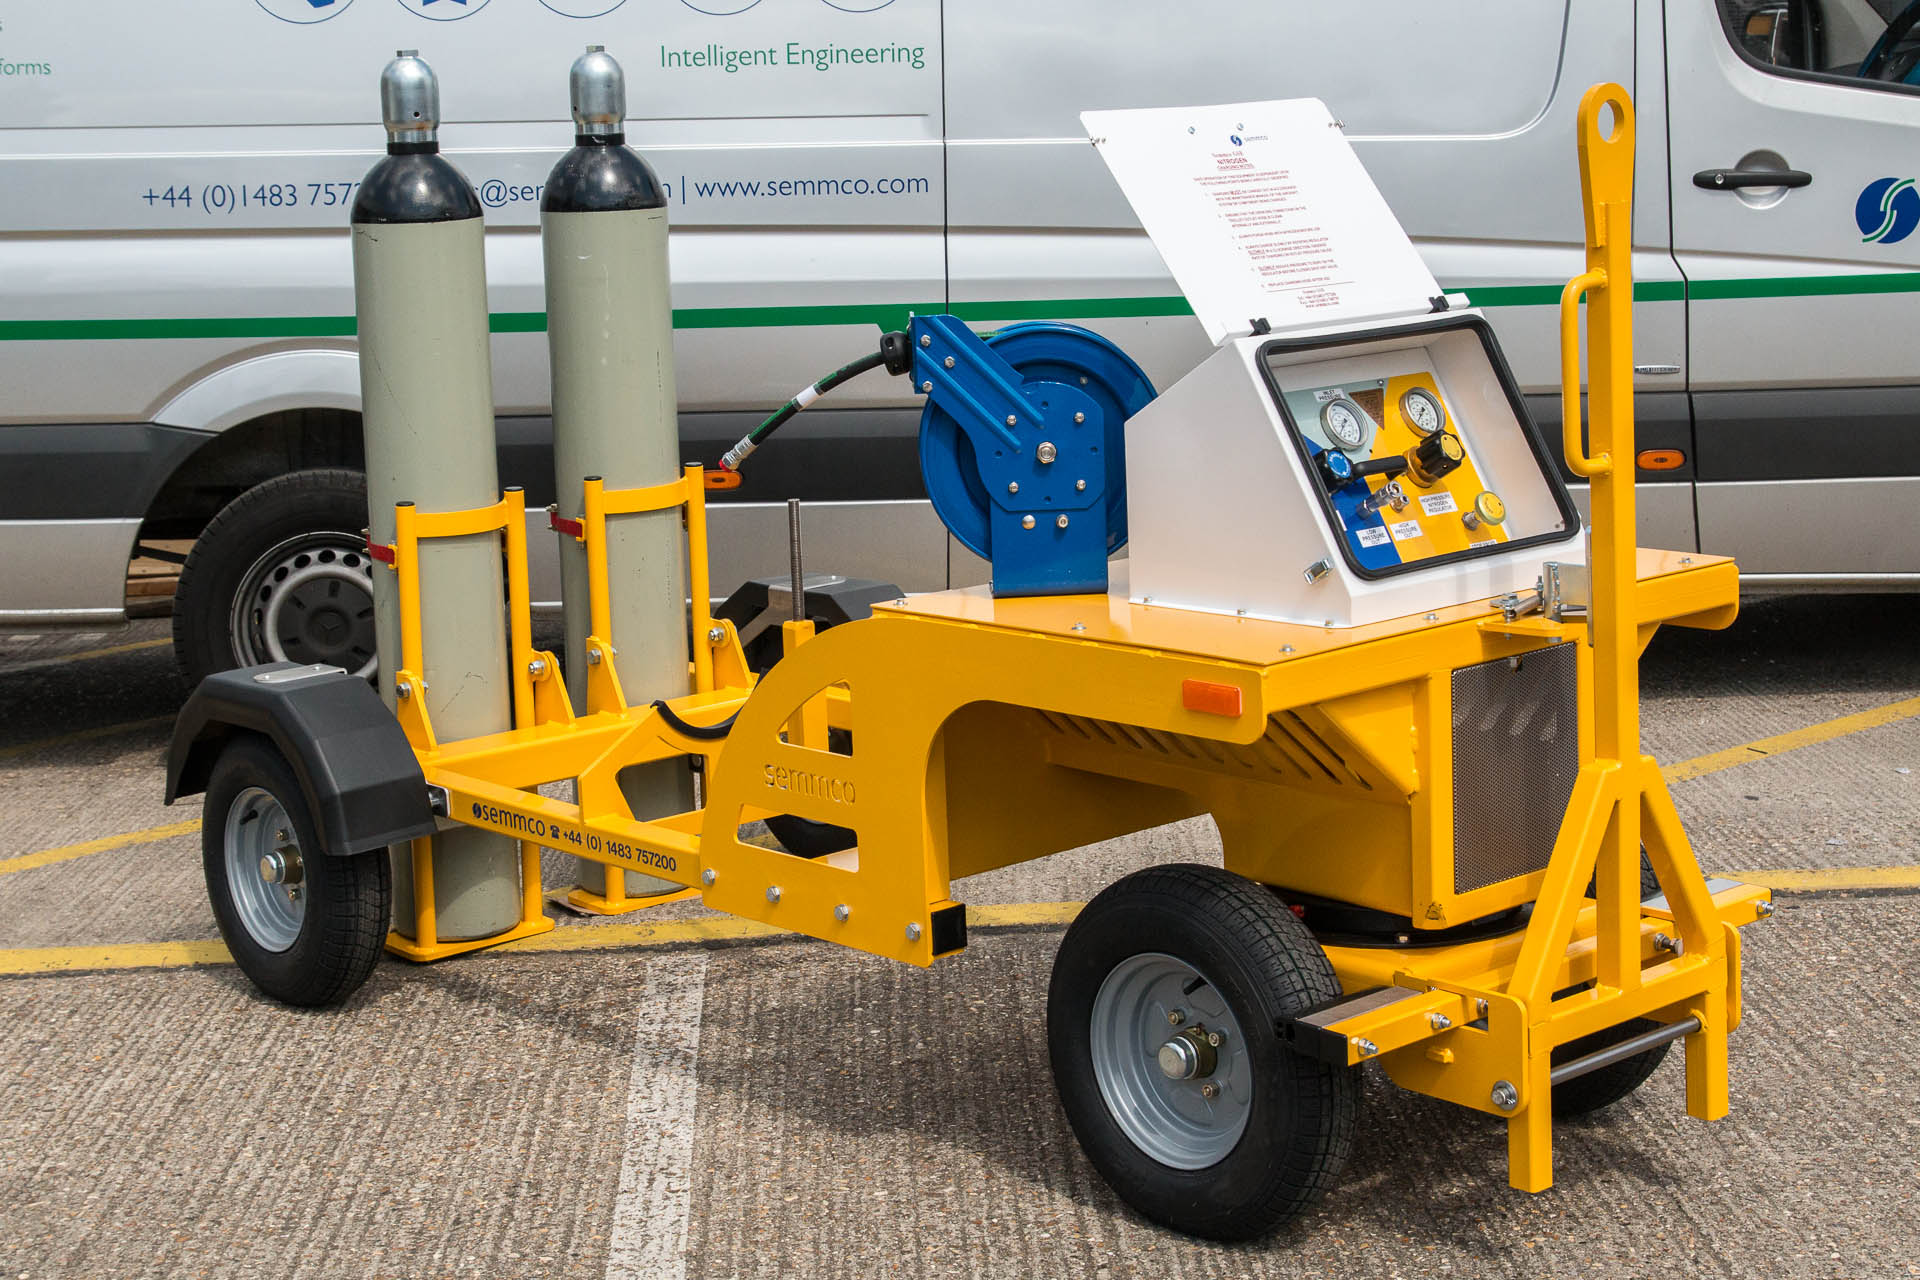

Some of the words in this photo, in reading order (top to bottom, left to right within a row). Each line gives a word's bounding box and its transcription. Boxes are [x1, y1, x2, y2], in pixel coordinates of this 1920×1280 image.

[660, 43, 779, 73] Intelligent
[786, 40, 926, 72] Engineering
[143, 186, 192, 209] +44
[308, 184, 361, 207] 757
[695, 176, 929, 199] www.semmco.com
[764, 763, 856, 806] semmco
[482, 803, 546, 838] semmco
[563, 830, 582, 846] +44
[586, 834, 602, 853] (0)
[605, 841, 632, 860] 1483
[635, 847, 676, 872] 757200
